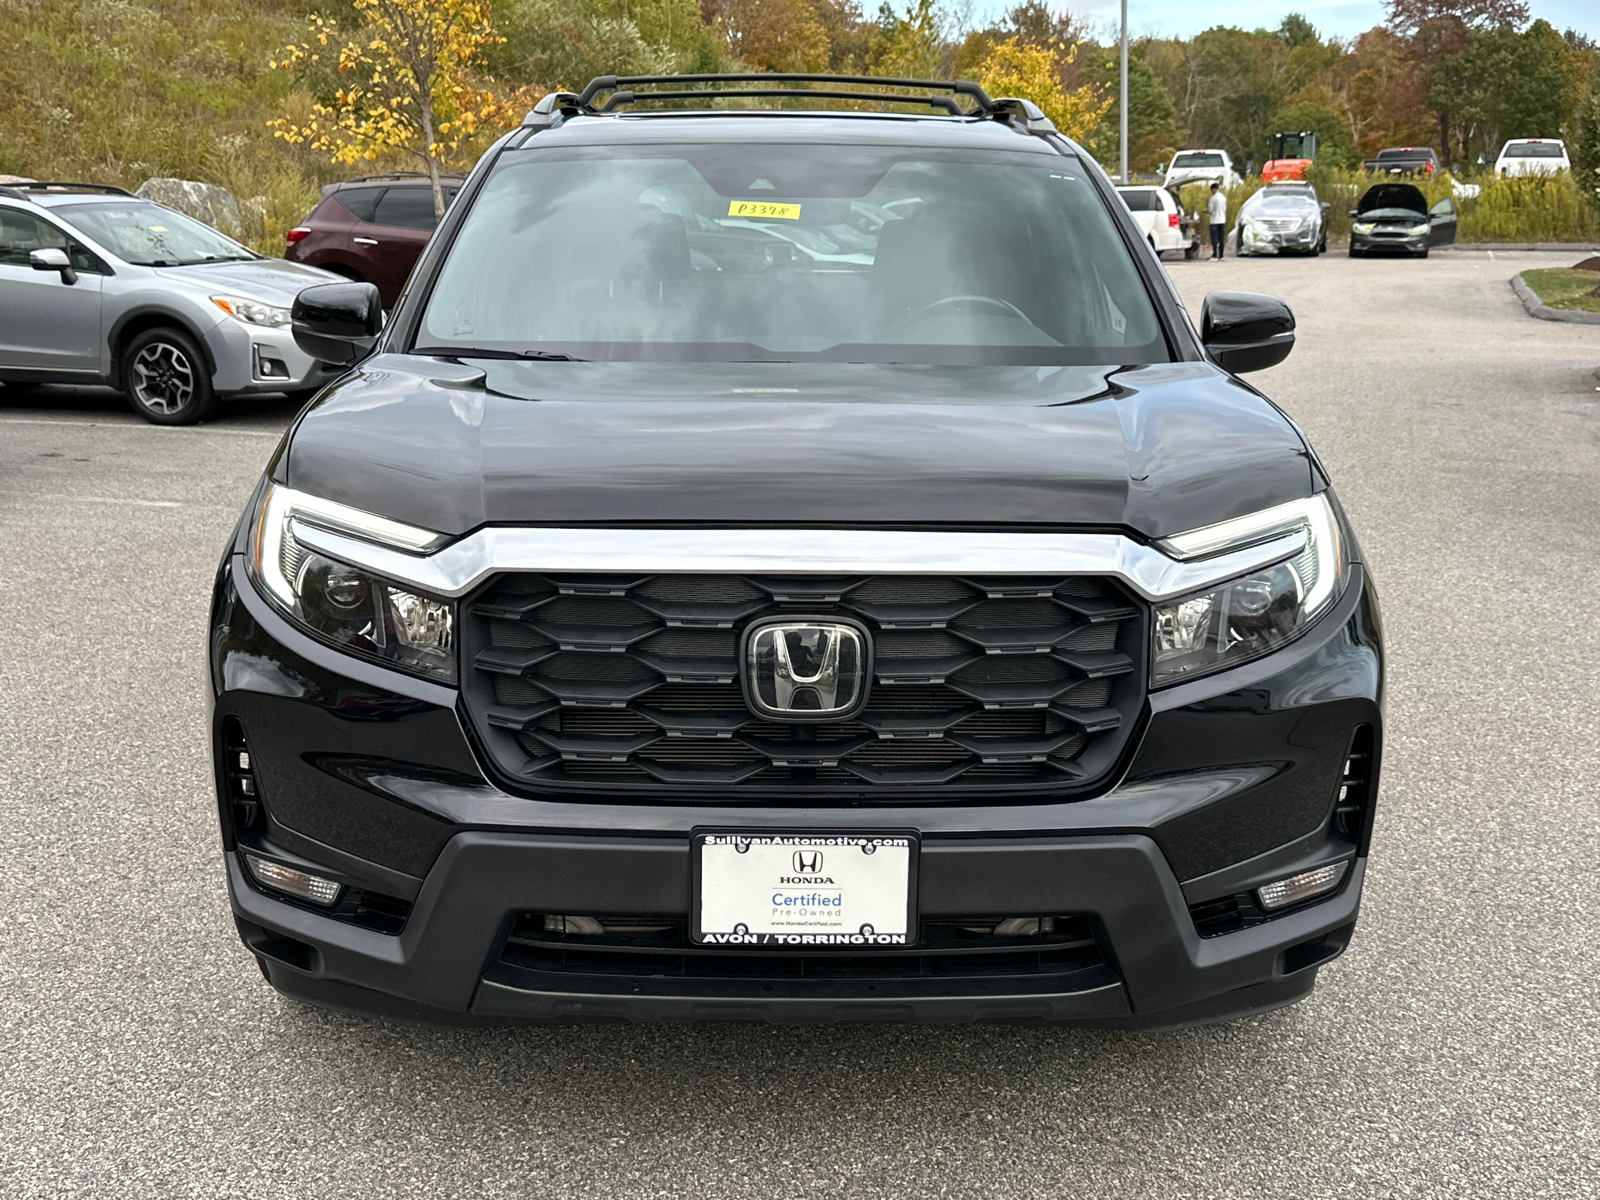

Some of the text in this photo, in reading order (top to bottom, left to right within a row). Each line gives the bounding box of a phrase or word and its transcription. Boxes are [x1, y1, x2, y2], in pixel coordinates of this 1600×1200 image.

[704, 836, 908, 846] SullivanAutomotive.com
[772, 893, 842, 906] Certified
[772, 908, 841, 916] Pre-Owned
[703, 934, 758, 944] AVON
[775, 934, 906, 944] TORRINGTON
